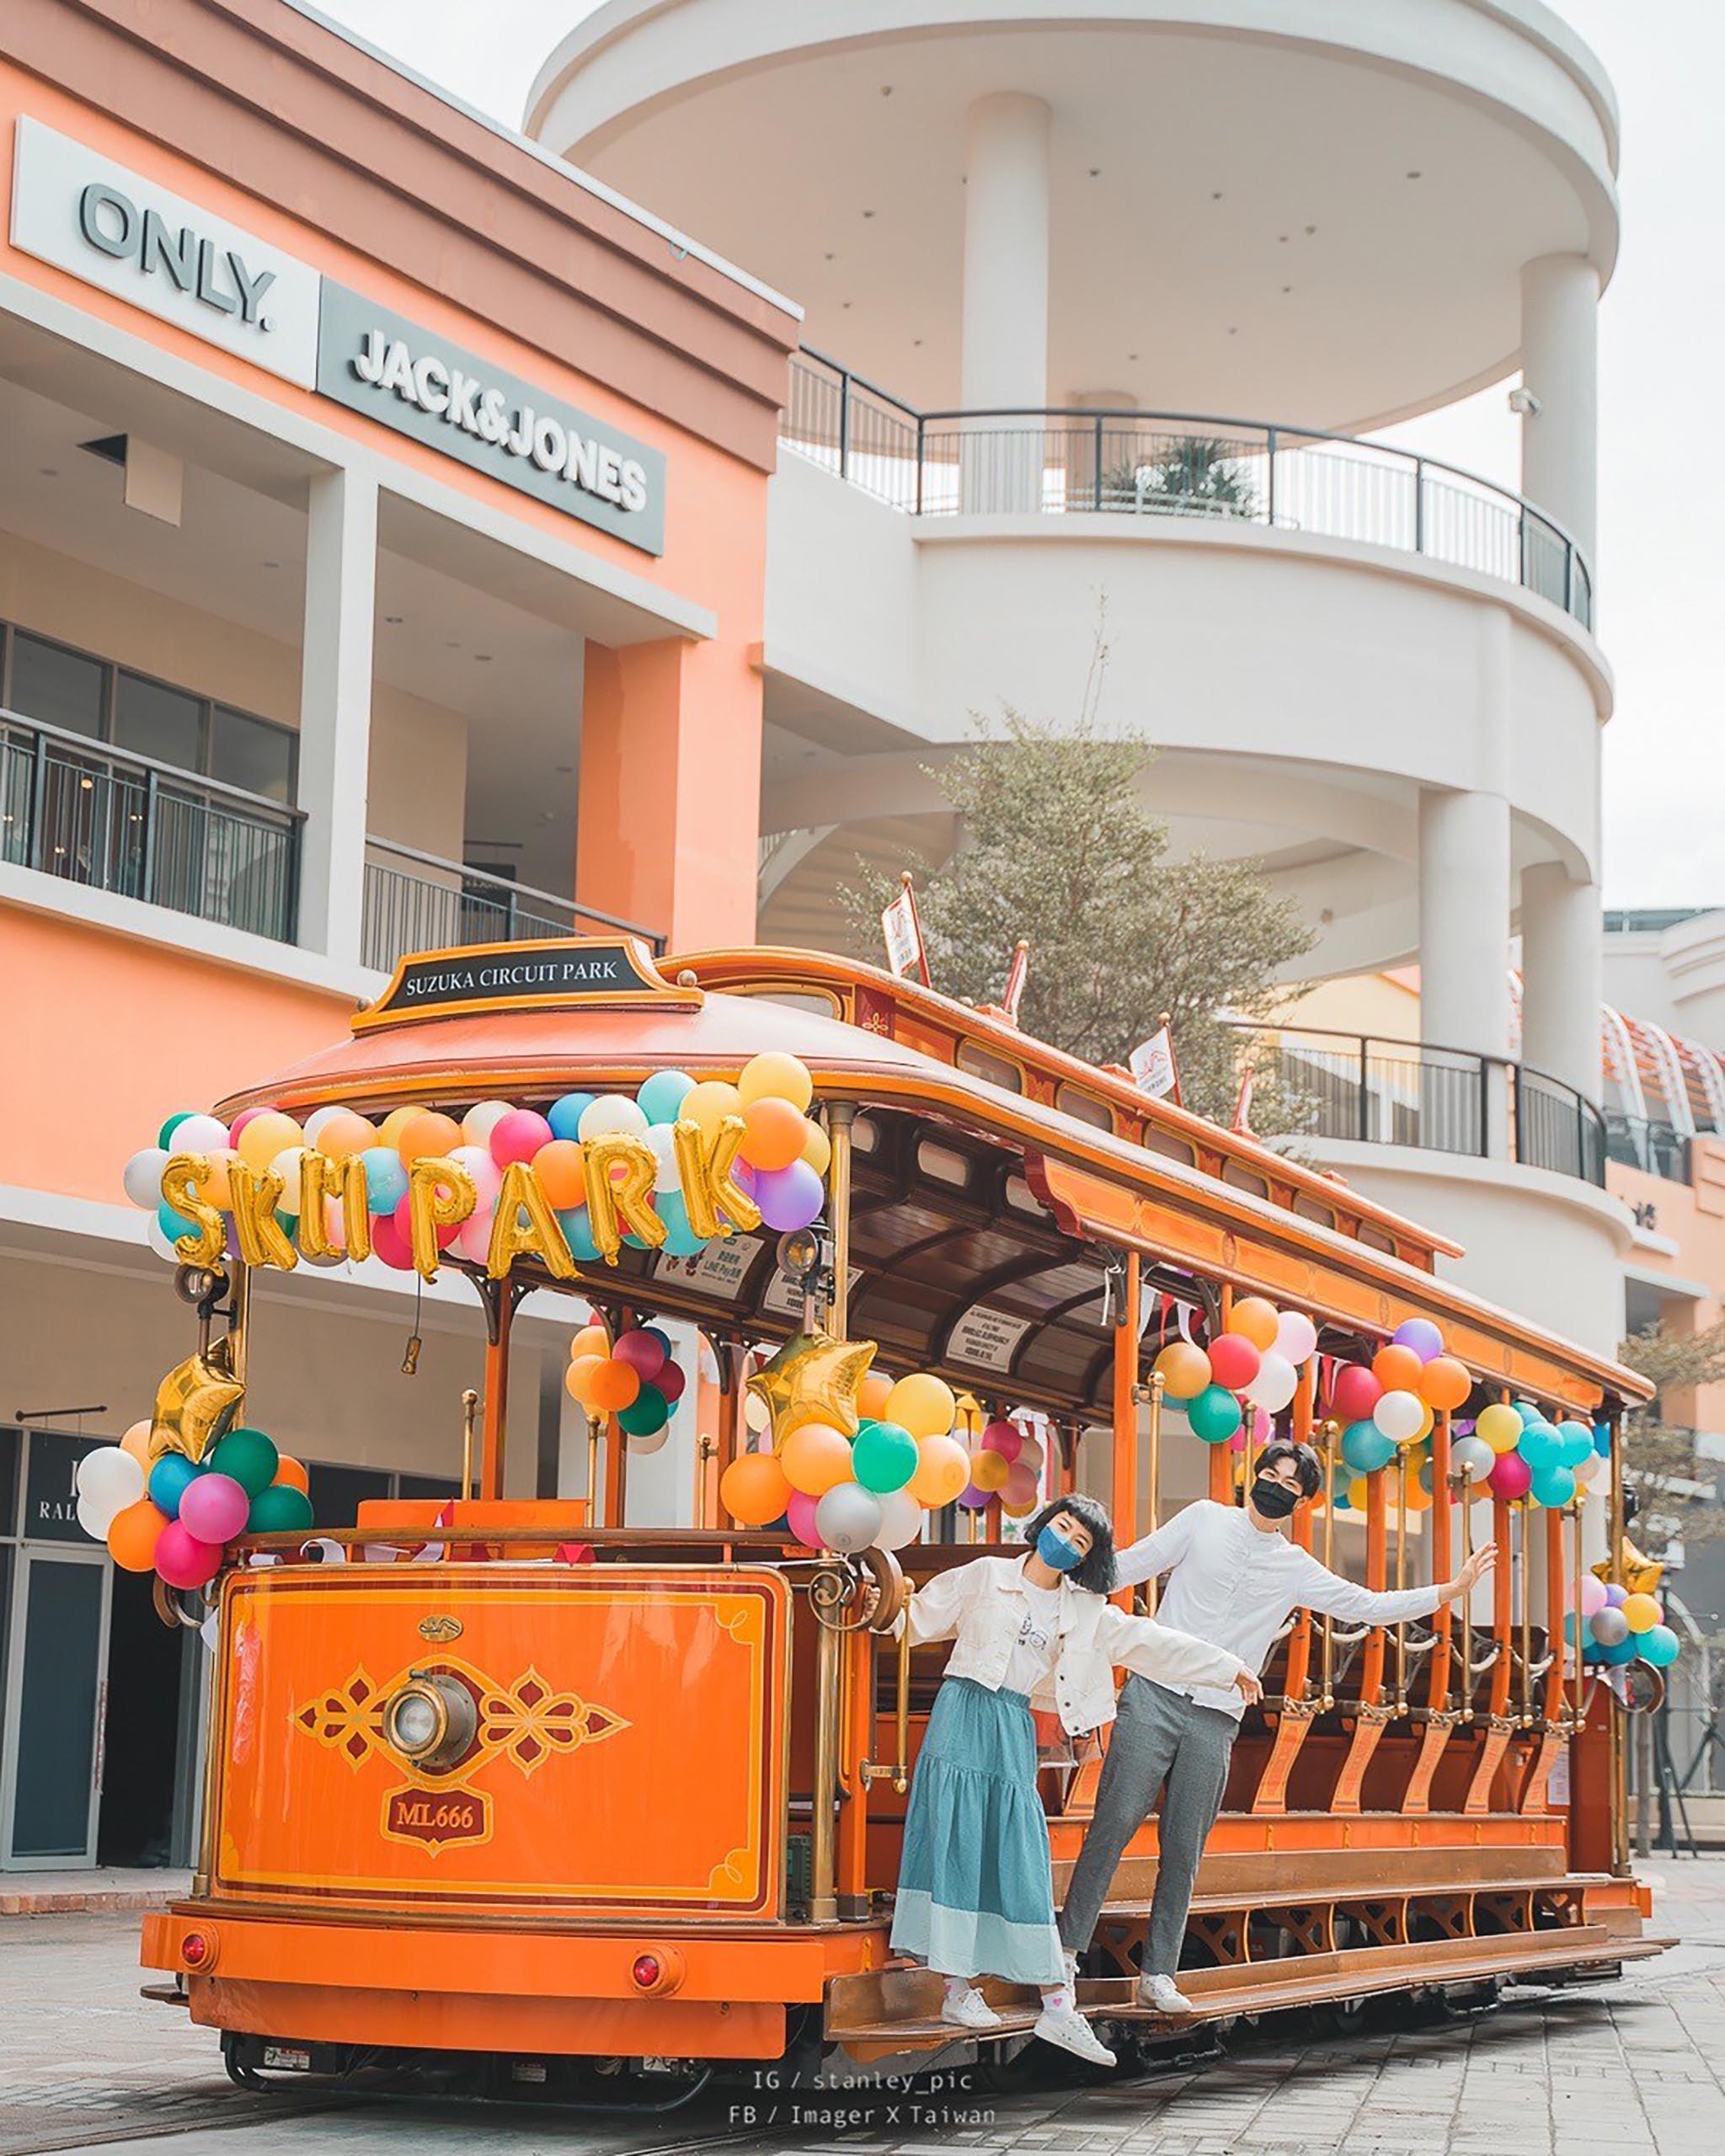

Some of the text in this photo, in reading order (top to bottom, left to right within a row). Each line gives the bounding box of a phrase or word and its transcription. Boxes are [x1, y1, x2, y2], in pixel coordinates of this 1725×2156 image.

[79, 183, 278, 333] ONLY.
[355, 329, 648, 513] JACK&JONES
[406, 961, 617, 995] SUZUKA CIRCUIT PARK
[161, 1114, 762, 1285] SKM PARK
[397, 1801, 473, 1829] ML666
